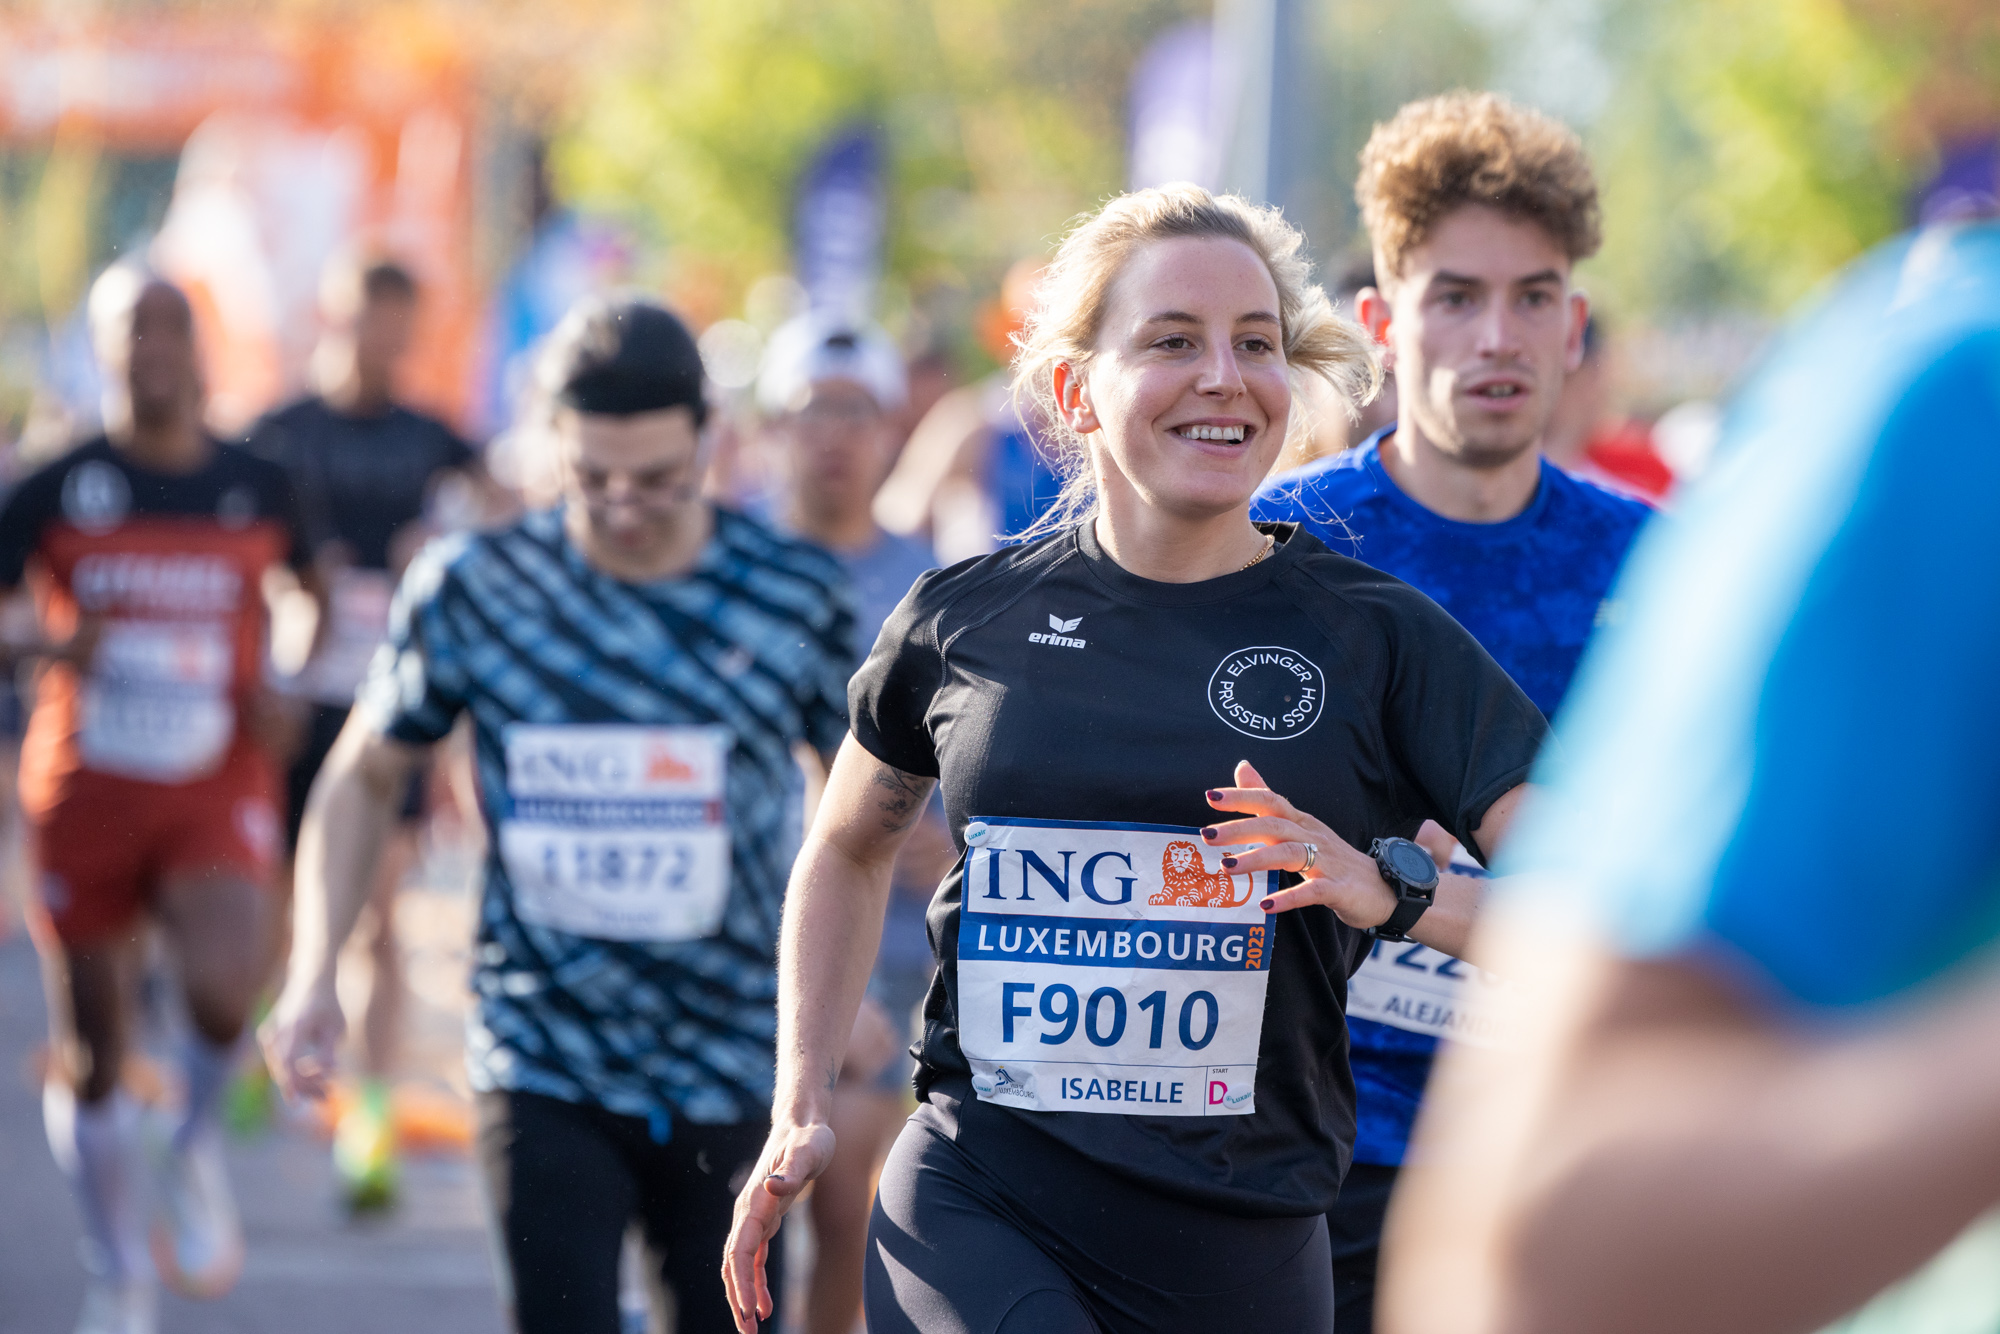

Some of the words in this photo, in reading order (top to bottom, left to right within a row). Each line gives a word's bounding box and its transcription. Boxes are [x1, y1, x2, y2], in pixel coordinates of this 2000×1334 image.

[1028, 632, 1087, 649] erima
[1226, 653, 1313, 683] ELVINGER
[1218, 681, 1277, 731] PRUSSEN
[1282, 687, 1317, 728] HOSS
[982, 847, 1138, 905] ING
[977, 924, 1244, 962] LUXEMBOURG
[1245, 926, 1266, 969] 2023
[1002, 982, 1219, 1051] F9010
[1061, 1077, 1184, 1104] ISABELLE
[1208, 1080, 1229, 1106] D
[1231, 1091, 1253, 1104] Luxair
